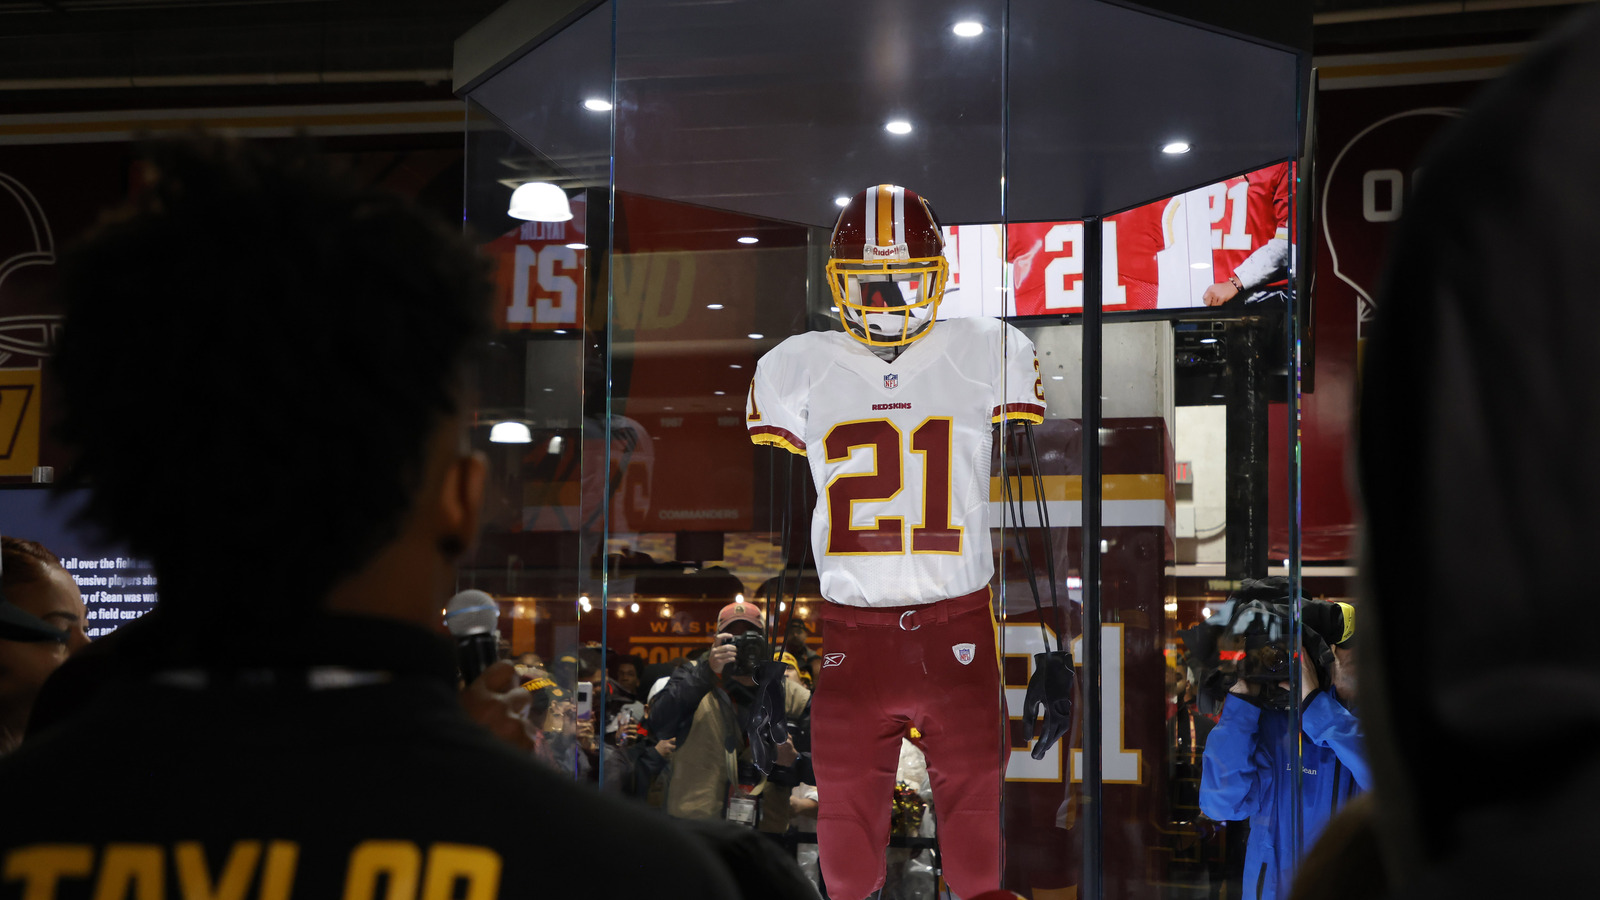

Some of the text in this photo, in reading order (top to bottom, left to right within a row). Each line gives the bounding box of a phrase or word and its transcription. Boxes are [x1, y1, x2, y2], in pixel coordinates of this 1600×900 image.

[873, 246, 899, 256] Riddell
[1045, 221, 1127, 309] 21
[872, 402, 912, 411] REDSKINS
[822, 416, 964, 556] 21
[658, 508, 739, 520] COMMANDERS
[66, 558, 78, 569] all
[79, 560, 99, 569] over
[99, 558, 115, 569] the
[108, 574, 141, 588] players
[90, 590, 100, 603] of
[100, 591, 123, 603] Sean
[123, 593, 142, 603] was
[98, 608, 119, 619] field
[120, 610, 136, 619] cuz
